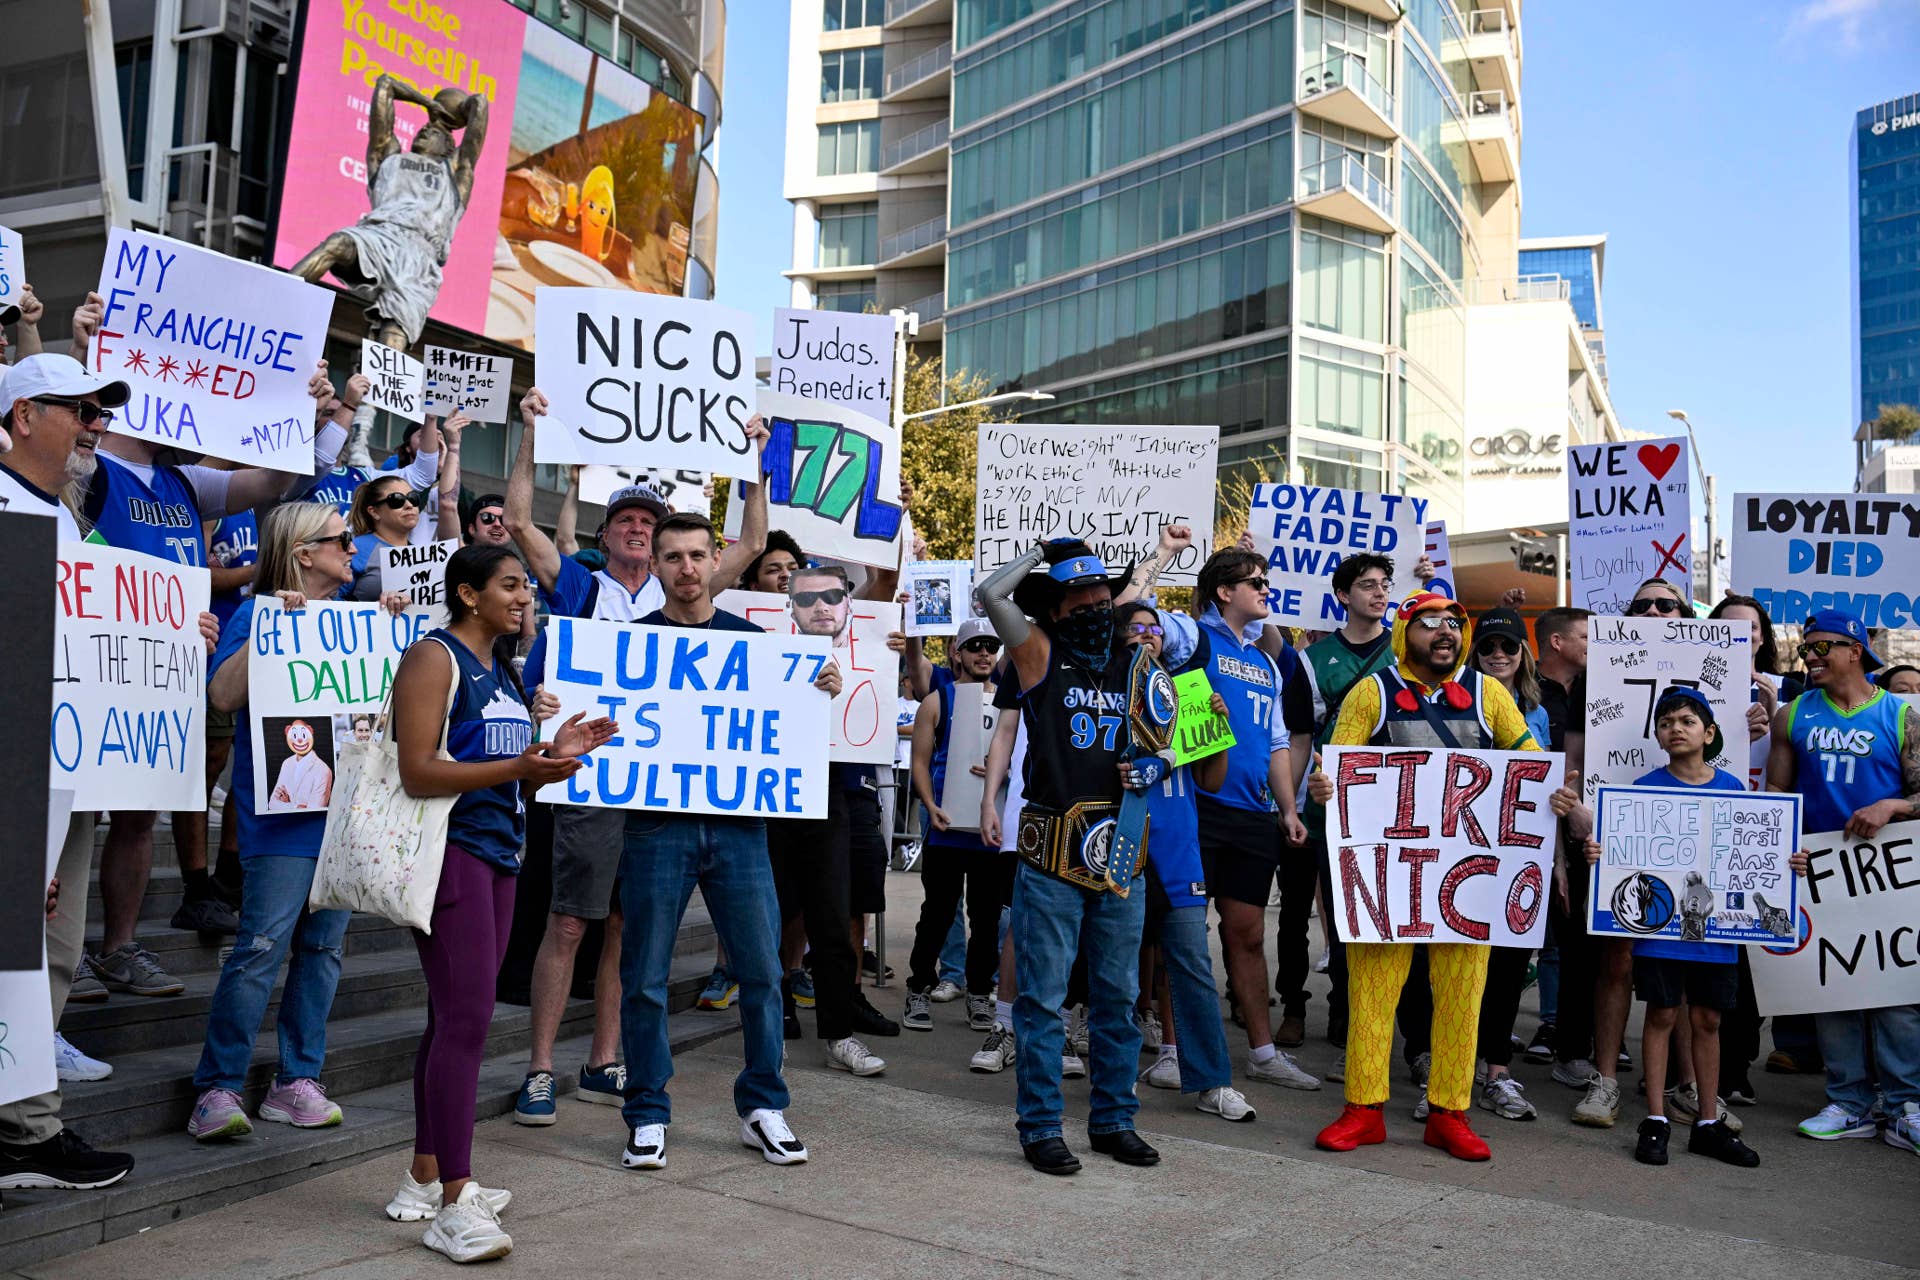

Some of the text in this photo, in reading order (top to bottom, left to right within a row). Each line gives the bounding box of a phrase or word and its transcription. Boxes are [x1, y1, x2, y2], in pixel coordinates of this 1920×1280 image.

[340, 0, 467, 85] Yourself
[467, 58, 496, 103] In
[115, 240, 176, 293] MY
[103, 288, 303, 373] FRANCHISE
[577, 312, 741, 381] NICO
[777, 318, 879, 366] Judas.
[369, 344, 415, 377] SELL
[431, 349, 500, 373] #MFFL
[372, 384, 414, 413] MAVS
[378, 372, 407, 390] THE
[426, 368, 495, 393] Money First
[578, 377, 751, 455] SUCKS
[1470, 429, 1562, 458] CIRQUE
[1572, 445, 1627, 477] WE
[1098, 485, 1150, 507] MVP
[1251, 484, 1428, 525] LOYALTY
[1575, 483, 1687, 519] LUKA #77
[983, 503, 1008, 532] HE
[1020, 502, 1061, 535] HAD
[1069, 510, 1096, 536] US
[1102, 512, 1138, 537] IN
[1273, 513, 1398, 552] FADED
[1747, 498, 1920, 538] LOYALTY
[390, 543, 447, 568] DALLAS
[1268, 546, 1358, 577] AWA
[1580, 547, 1644, 585] Loyalty
[1788, 538, 1883, 577] DIED
[410, 569, 431, 584] ON
[116, 563, 184, 630] NICO
[256, 607, 306, 656] GET
[318, 608, 376, 654] OUT
[1664, 621, 1731, 649] Strong
[90, 634, 131, 685] THE
[138, 638, 199, 697] TEAM
[557, 619, 826, 691] LUKA 77
[1064, 686, 1127, 712] MAVS
[1247, 691, 1272, 729] 77
[1587, 697, 1611, 712] Dallas
[98, 706, 192, 773] AWAY
[597, 696, 659, 748] IS
[701, 705, 779, 755] THE
[1070, 712, 1122, 751] 97
[1180, 717, 1231, 754] LUKA
[1807, 726, 1876, 757] MAVS
[1608, 748, 1645, 767] MVP!
[1820, 753, 1855, 784] 77
[568, 753, 802, 813] CULTURE
[1337, 751, 1551, 849] FIRE
[1609, 799, 1700, 835] FIRE
[1607, 836, 1696, 866] NICO
[1710, 871, 1781, 891] LAST
[1807, 838, 1920, 904] FIRE
[1339, 843, 1543, 941] NICO
[1819, 927, 1920, 987] NIC
